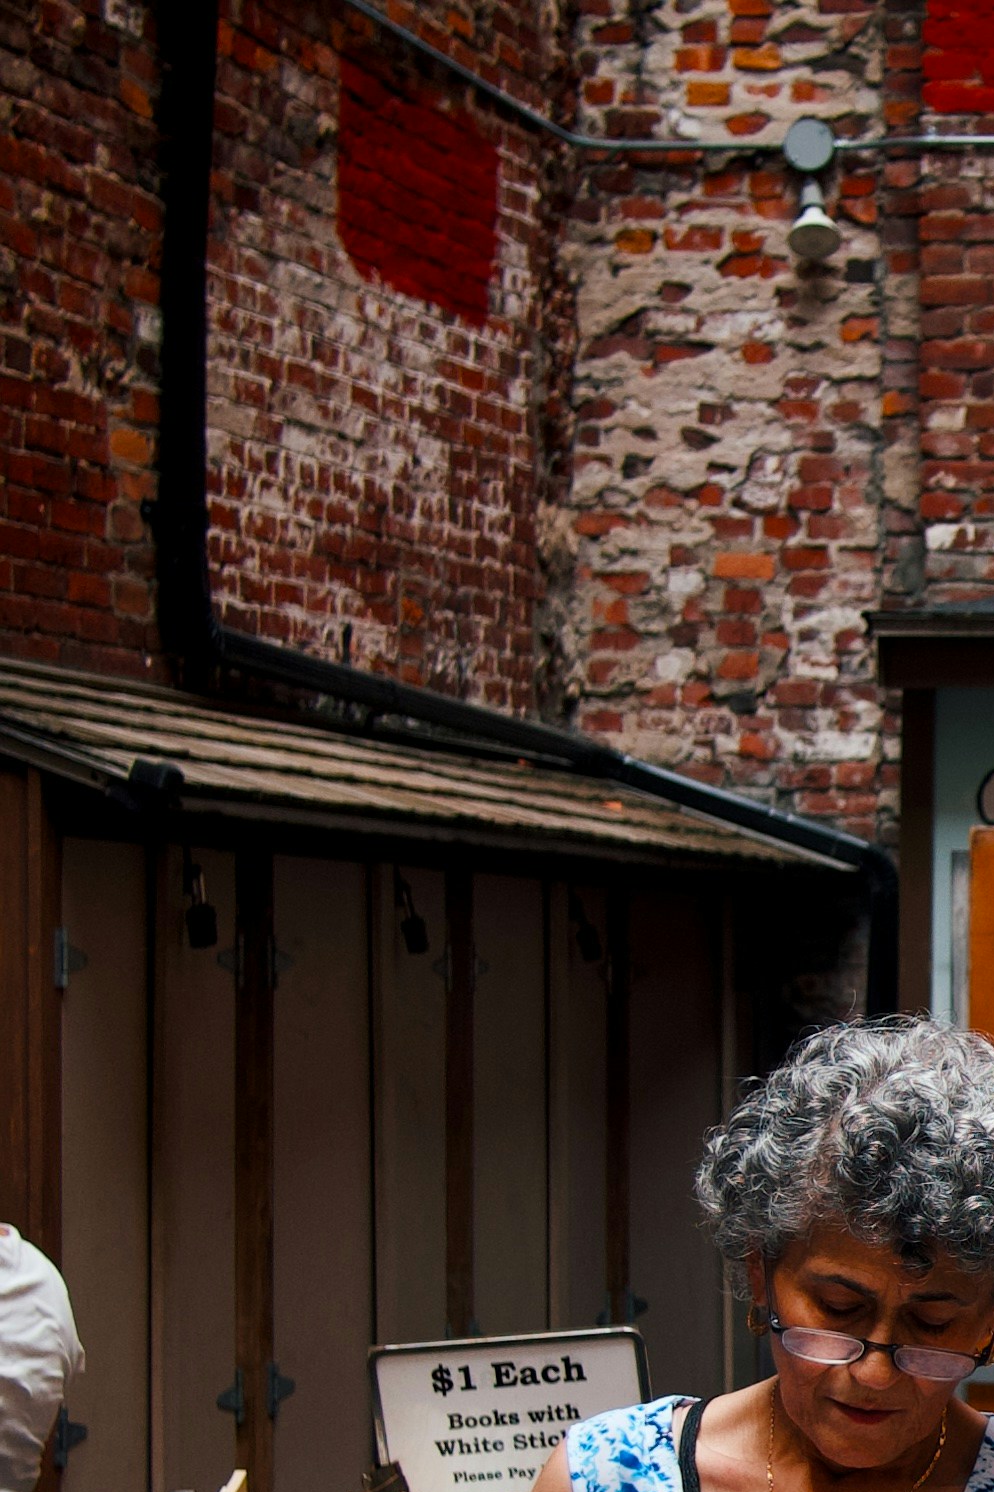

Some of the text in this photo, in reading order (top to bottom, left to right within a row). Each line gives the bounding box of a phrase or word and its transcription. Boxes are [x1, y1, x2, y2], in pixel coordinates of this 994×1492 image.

[431, 1356, 588, 1397] $1 Each
[448, 1404, 582, 1431] Books with
[435, 1436, 505, 1457] White
[453, 1467, 538, 1484] Please Pay
